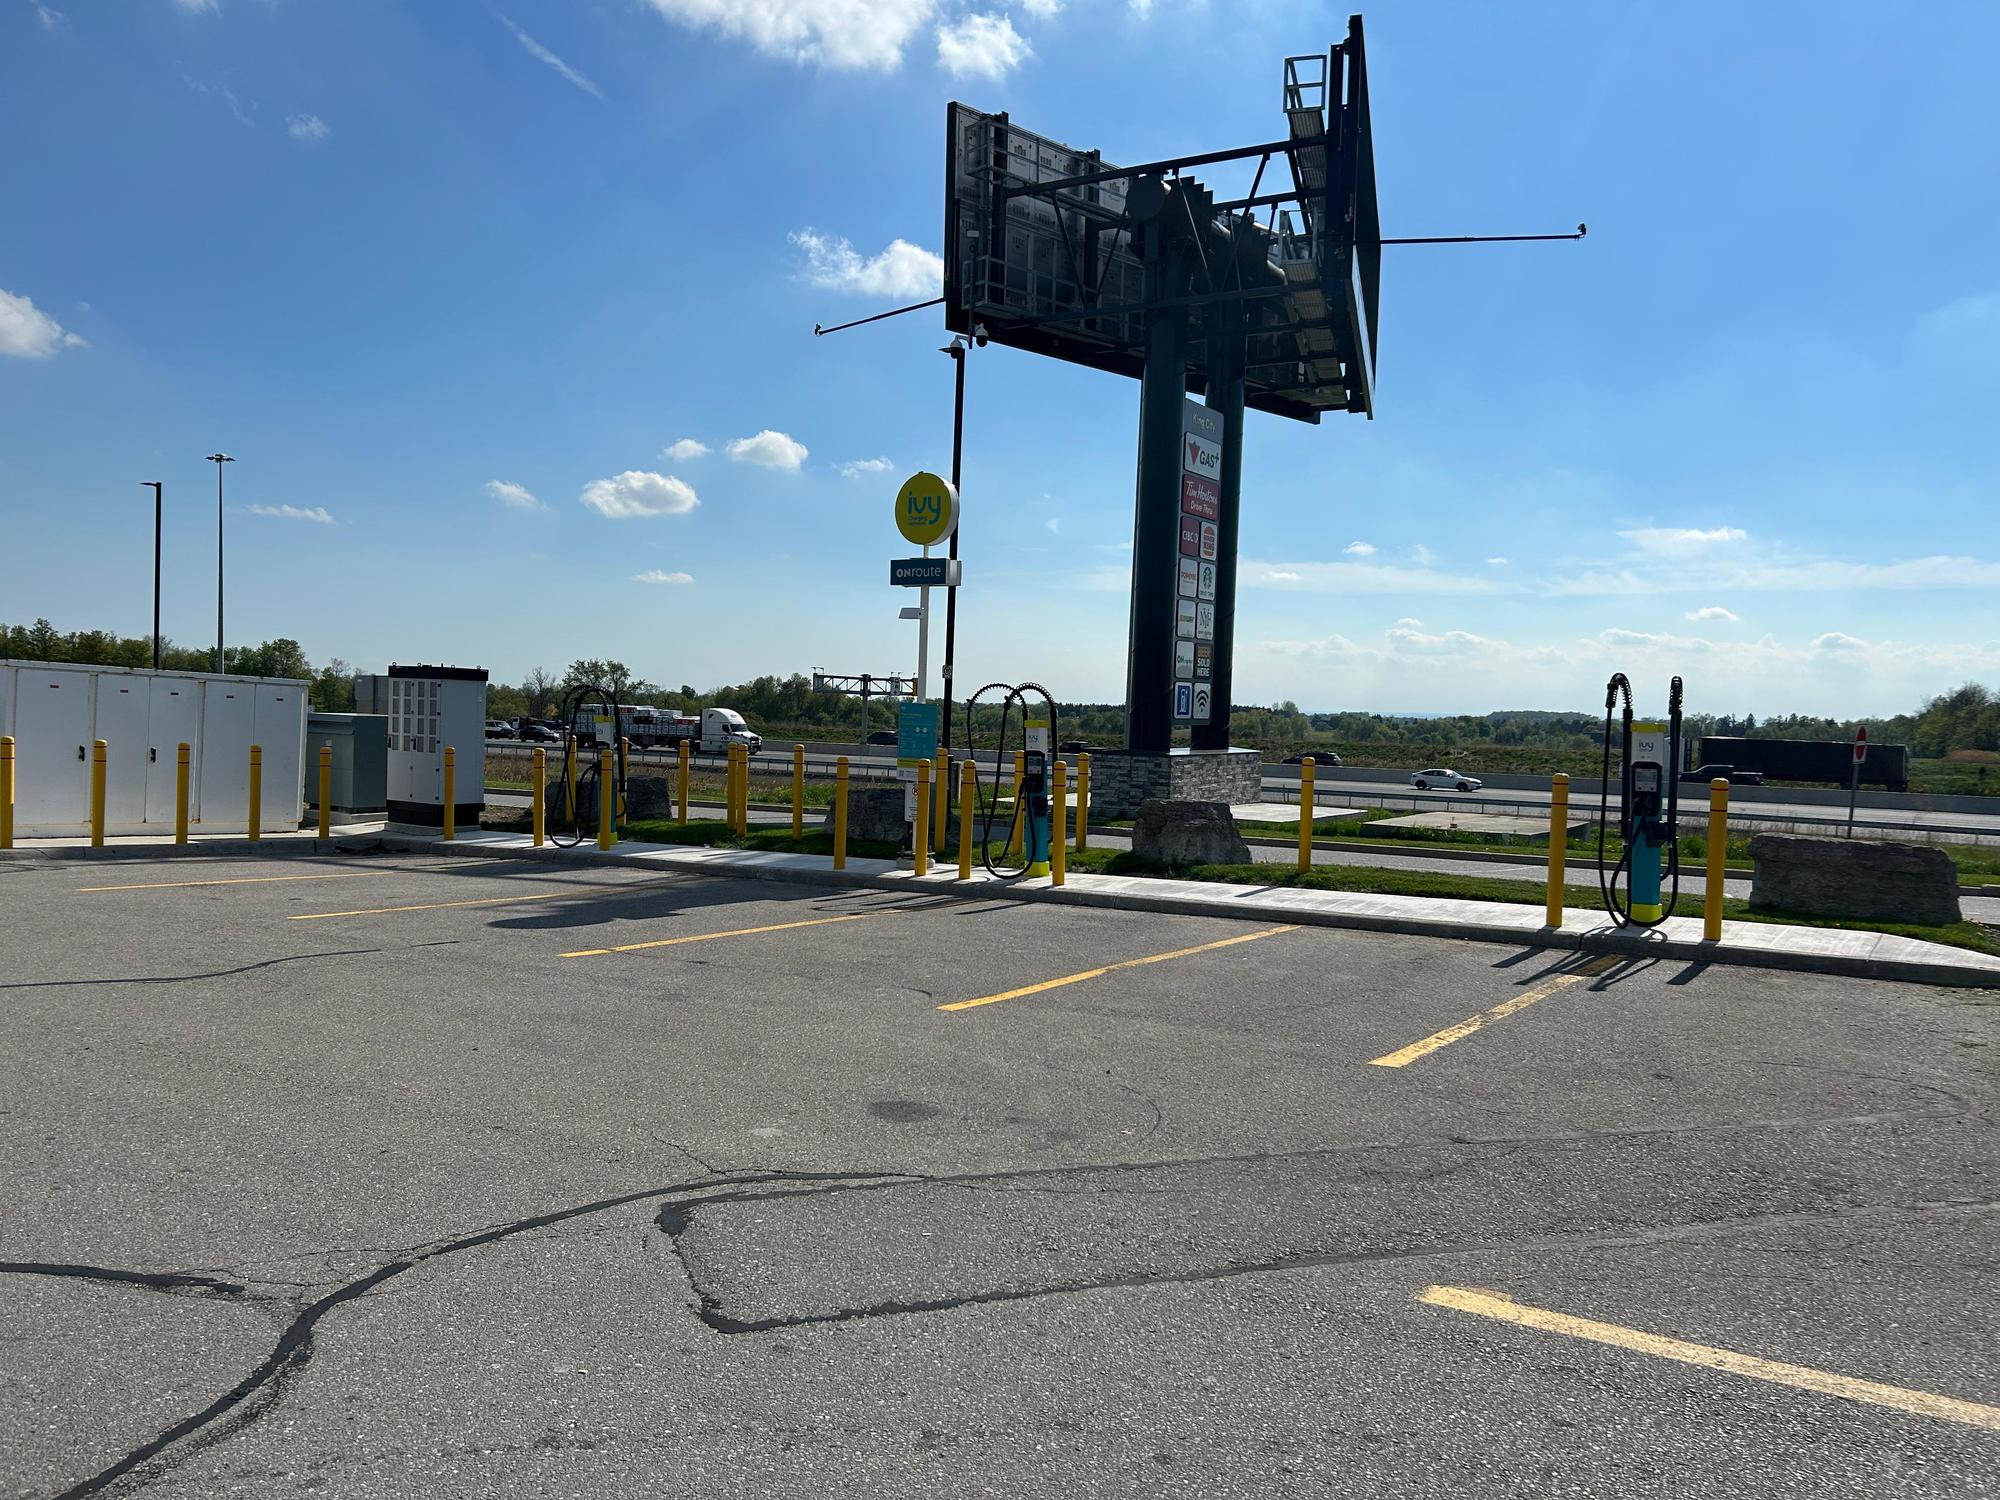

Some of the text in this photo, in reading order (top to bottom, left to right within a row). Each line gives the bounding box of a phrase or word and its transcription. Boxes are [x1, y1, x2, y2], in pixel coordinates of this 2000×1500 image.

[1205, 417, 1217, 432] City
[1186, 481, 1217, 504] Tim Hortons
[908, 490, 941, 525] ivy
[1190, 500, 1213, 515] Drive Thru
[1197, 657, 1210, 667] SOLD
[1196, 667, 1210, 677] HERE
